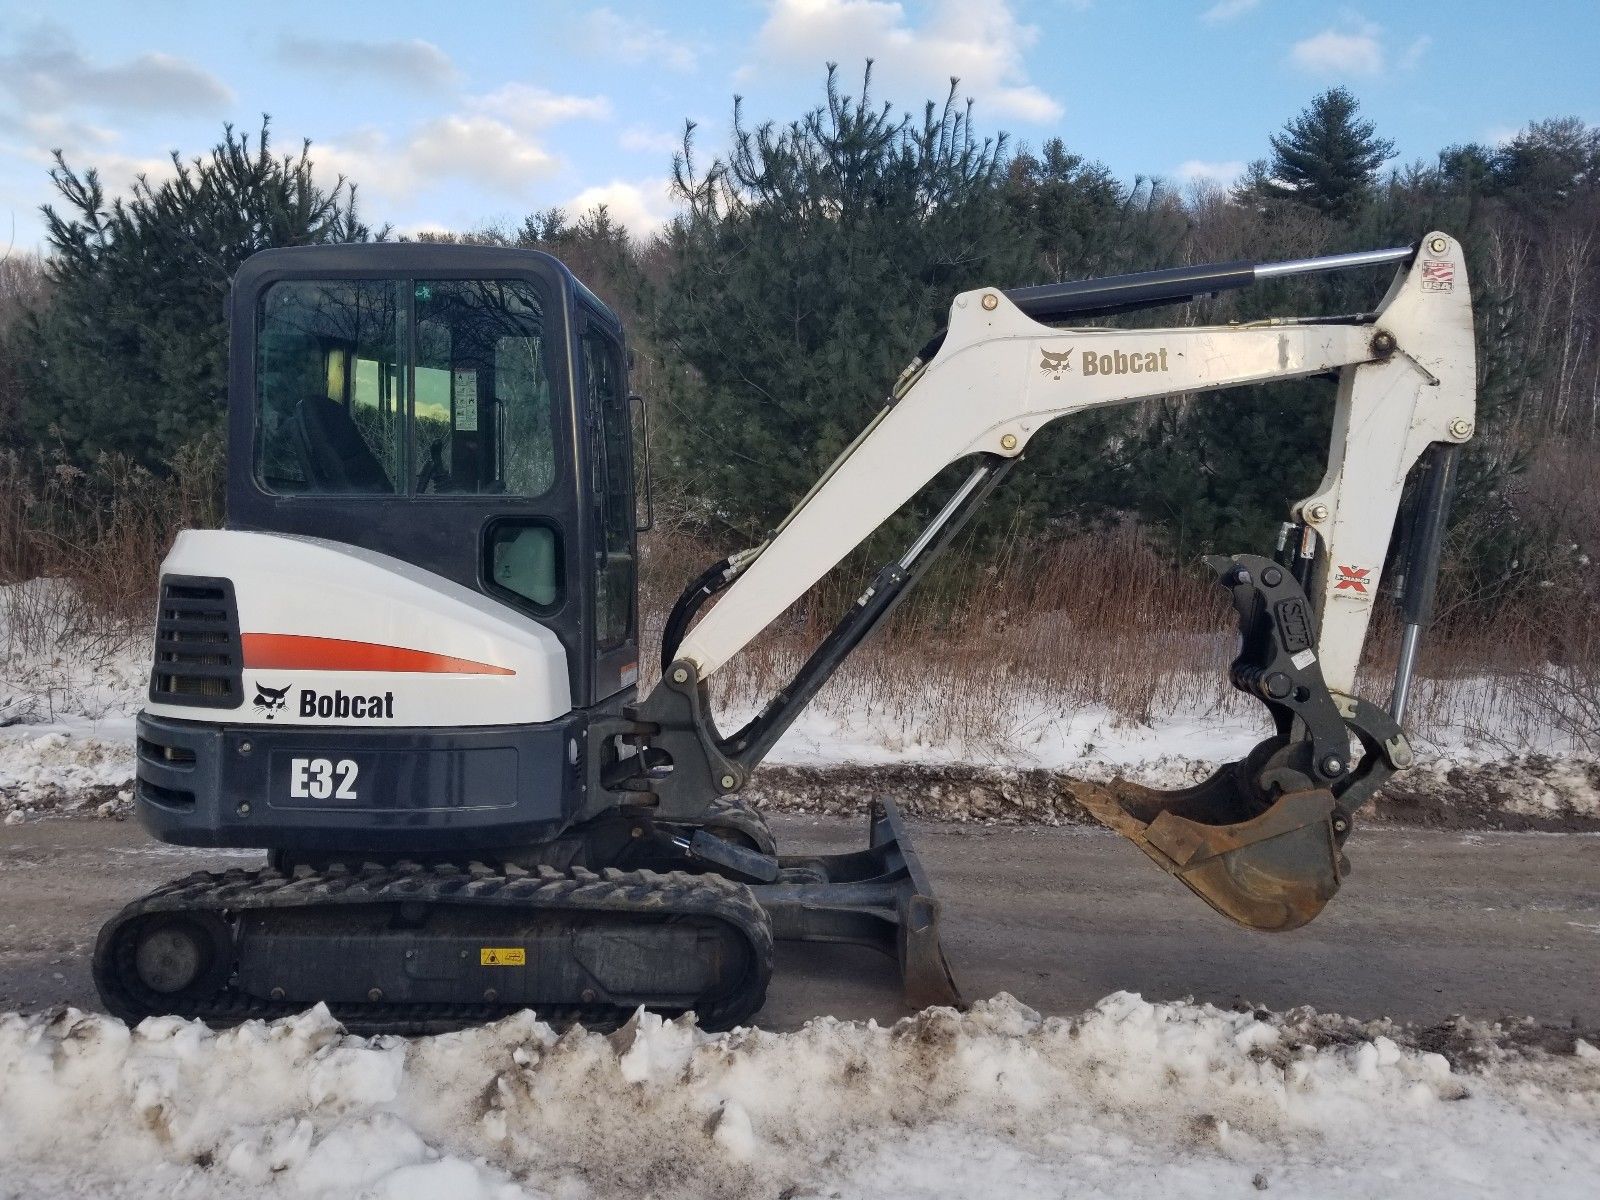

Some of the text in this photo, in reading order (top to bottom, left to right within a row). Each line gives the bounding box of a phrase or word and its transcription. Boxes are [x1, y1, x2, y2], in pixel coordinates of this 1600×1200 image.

[1082, 347, 1169, 376] Bobcat
[299, 689, 394, 719] Bobcat
[290, 758, 359, 800] E32
